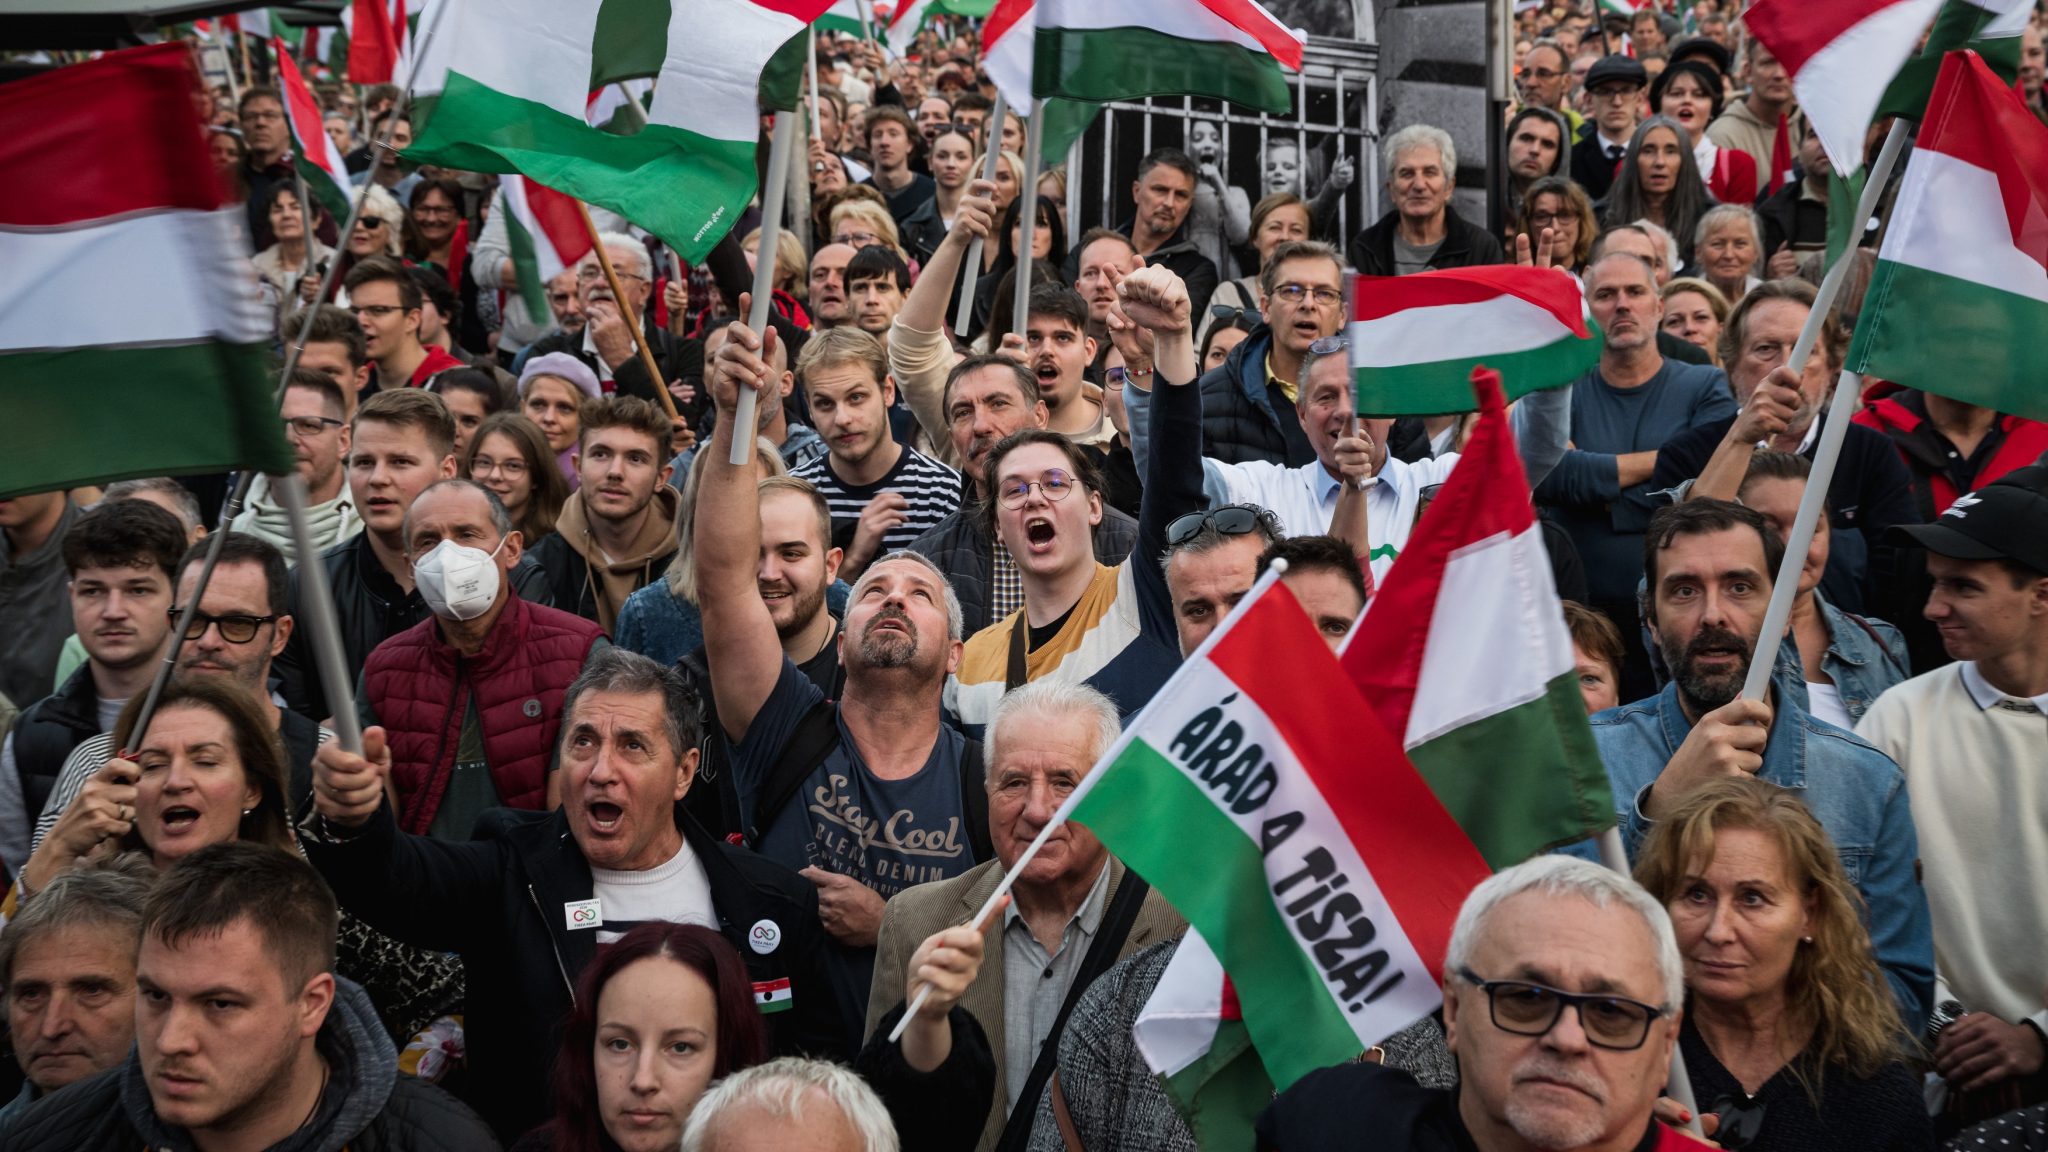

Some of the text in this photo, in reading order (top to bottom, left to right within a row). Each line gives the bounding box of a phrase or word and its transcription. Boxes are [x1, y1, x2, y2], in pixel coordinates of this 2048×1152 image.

[811, 774, 963, 852] Stay Cool
[1168, 691, 1279, 815] ÁRAD
[1261, 810, 1305, 859] A
[876, 859, 944, 883] DENIM
